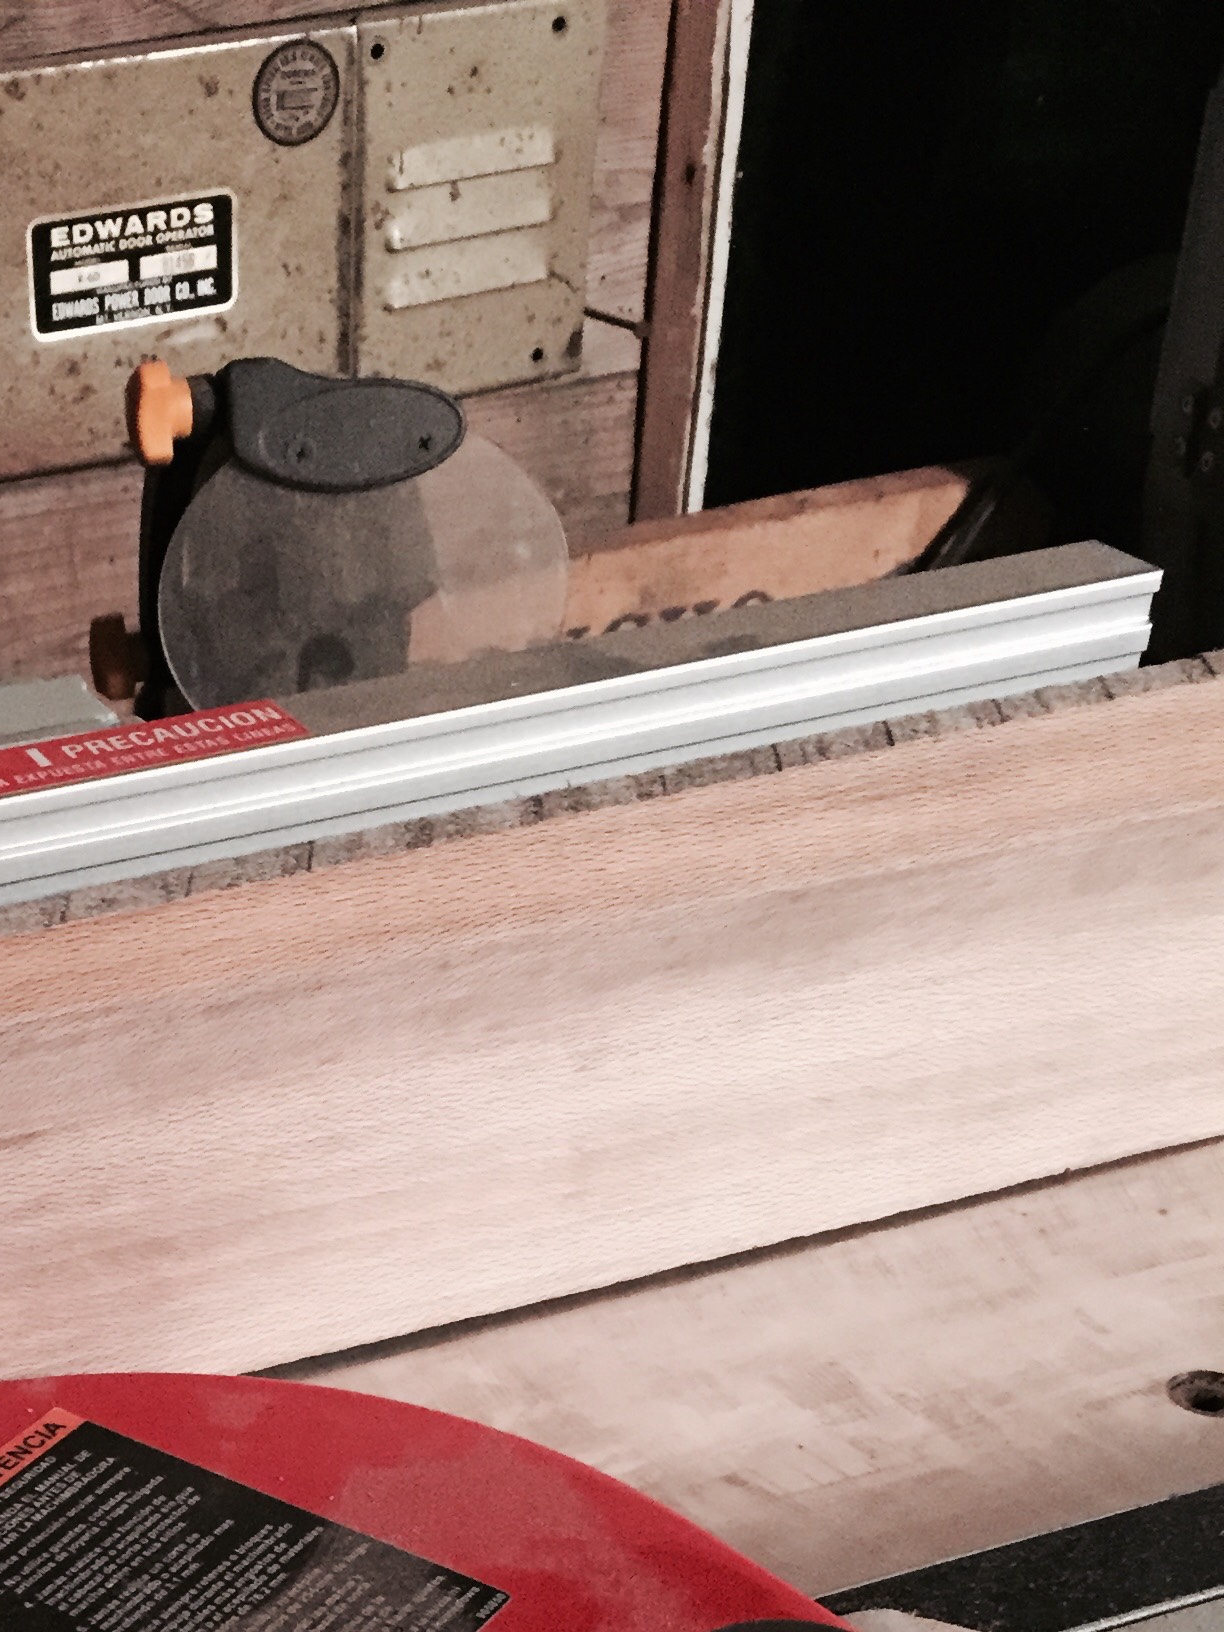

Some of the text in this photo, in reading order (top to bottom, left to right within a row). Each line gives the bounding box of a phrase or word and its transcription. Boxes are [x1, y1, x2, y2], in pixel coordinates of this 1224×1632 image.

[50, 203, 214, 248] EDWARDS
[50, 239, 116, 262] AUTOMATIC
[118, 235, 153, 251] DOOR
[156, 224, 215, 244] OPERATOR
[60, 705, 283, 760] PRECAUCION
[15, 758, 106, 784] EXPUESTA
[111, 747, 169, 768] ENTRE
[29, 1480, 69, 1508] ANTES
[32, 1460, 79, 1492] MANUAL
